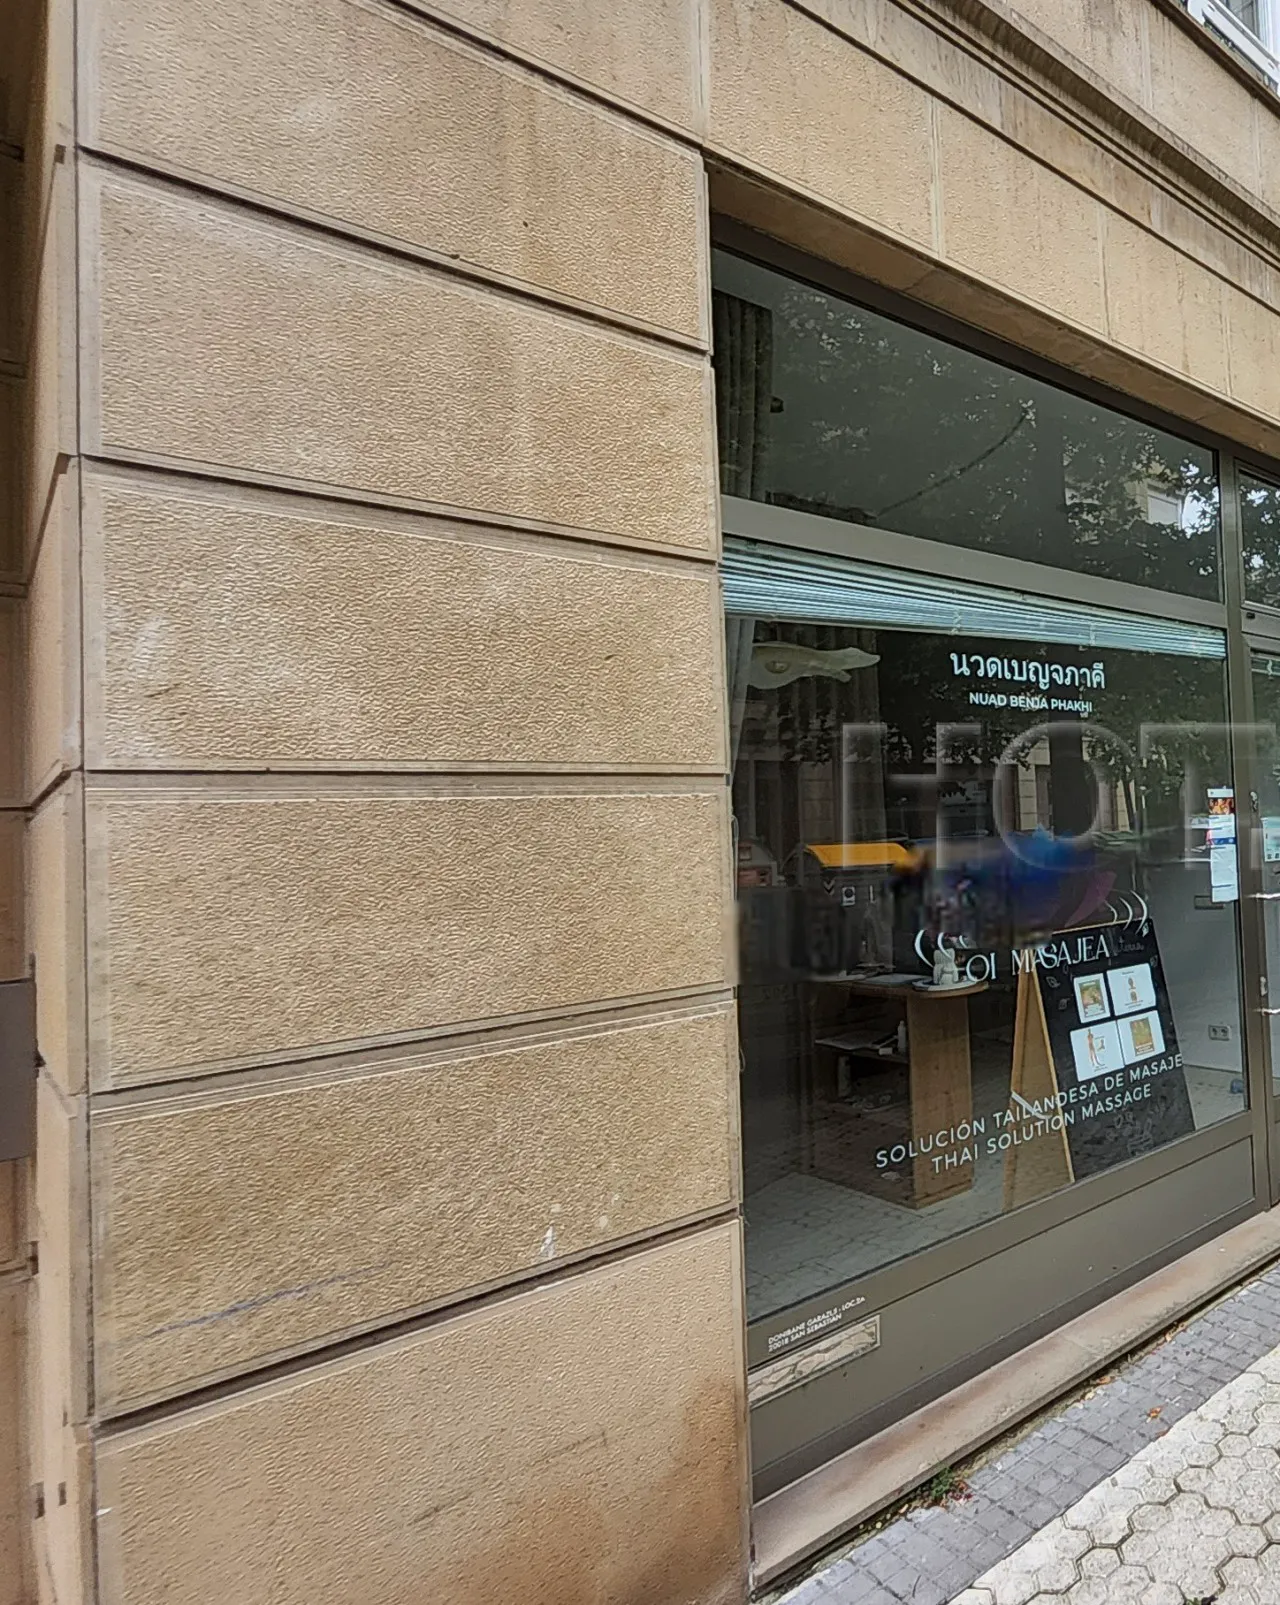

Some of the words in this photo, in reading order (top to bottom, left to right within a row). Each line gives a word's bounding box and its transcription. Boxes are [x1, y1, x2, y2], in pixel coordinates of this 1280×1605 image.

[950, 652, 1105, 690] นวดเบญจภาคี
[969, 692, 1007, 707] NUAD
[1010, 695, 1048, 710] BENJA
[1051, 699, 1092, 713] PHAKHI
[1011, 934, 1110, 976] MASAJEA
[876, 1119, 985, 1168] SOLUCIÓN
[993, 1078, 1098, 1129] TAILANDESA
[1104, 1072, 1124, 1091] DE
[1129, 1052, 1183, 1083] MASAJE
[932, 1147, 979, 1174] THAI
[986, 1110, 1075, 1155] SOLUTION
[1081, 1083, 1152, 1121] MASSAGE
[791, 1329, 806, 1342] SAN
